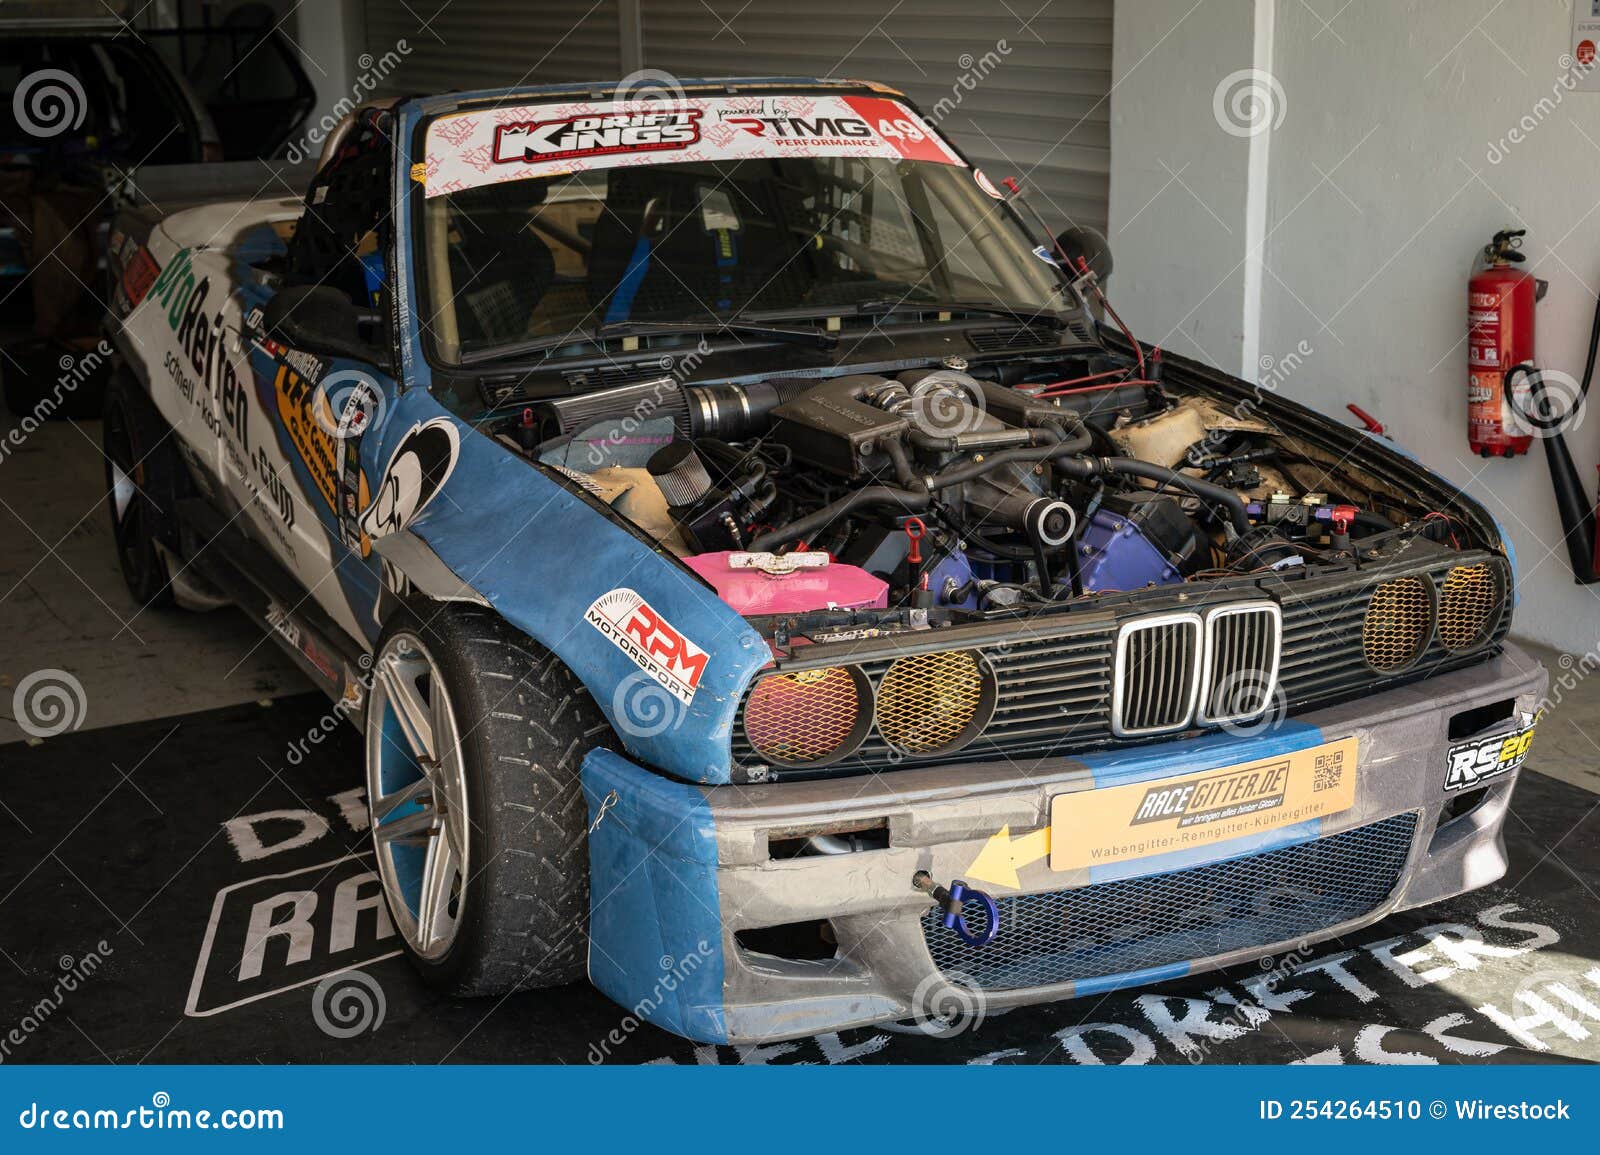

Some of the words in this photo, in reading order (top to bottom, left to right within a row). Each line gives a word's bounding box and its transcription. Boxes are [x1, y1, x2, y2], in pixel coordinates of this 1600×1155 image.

[716, 100, 766, 121] powered
[772, 99, 790, 122] by
[726, 117, 872, 138] RTMG
[878, 118, 925, 144] 49
[774, 138, 879, 148] PERFORMANCE
[586, 609, 693, 701] MOTORSPORT
[624, 602, 711, 690] RPM
